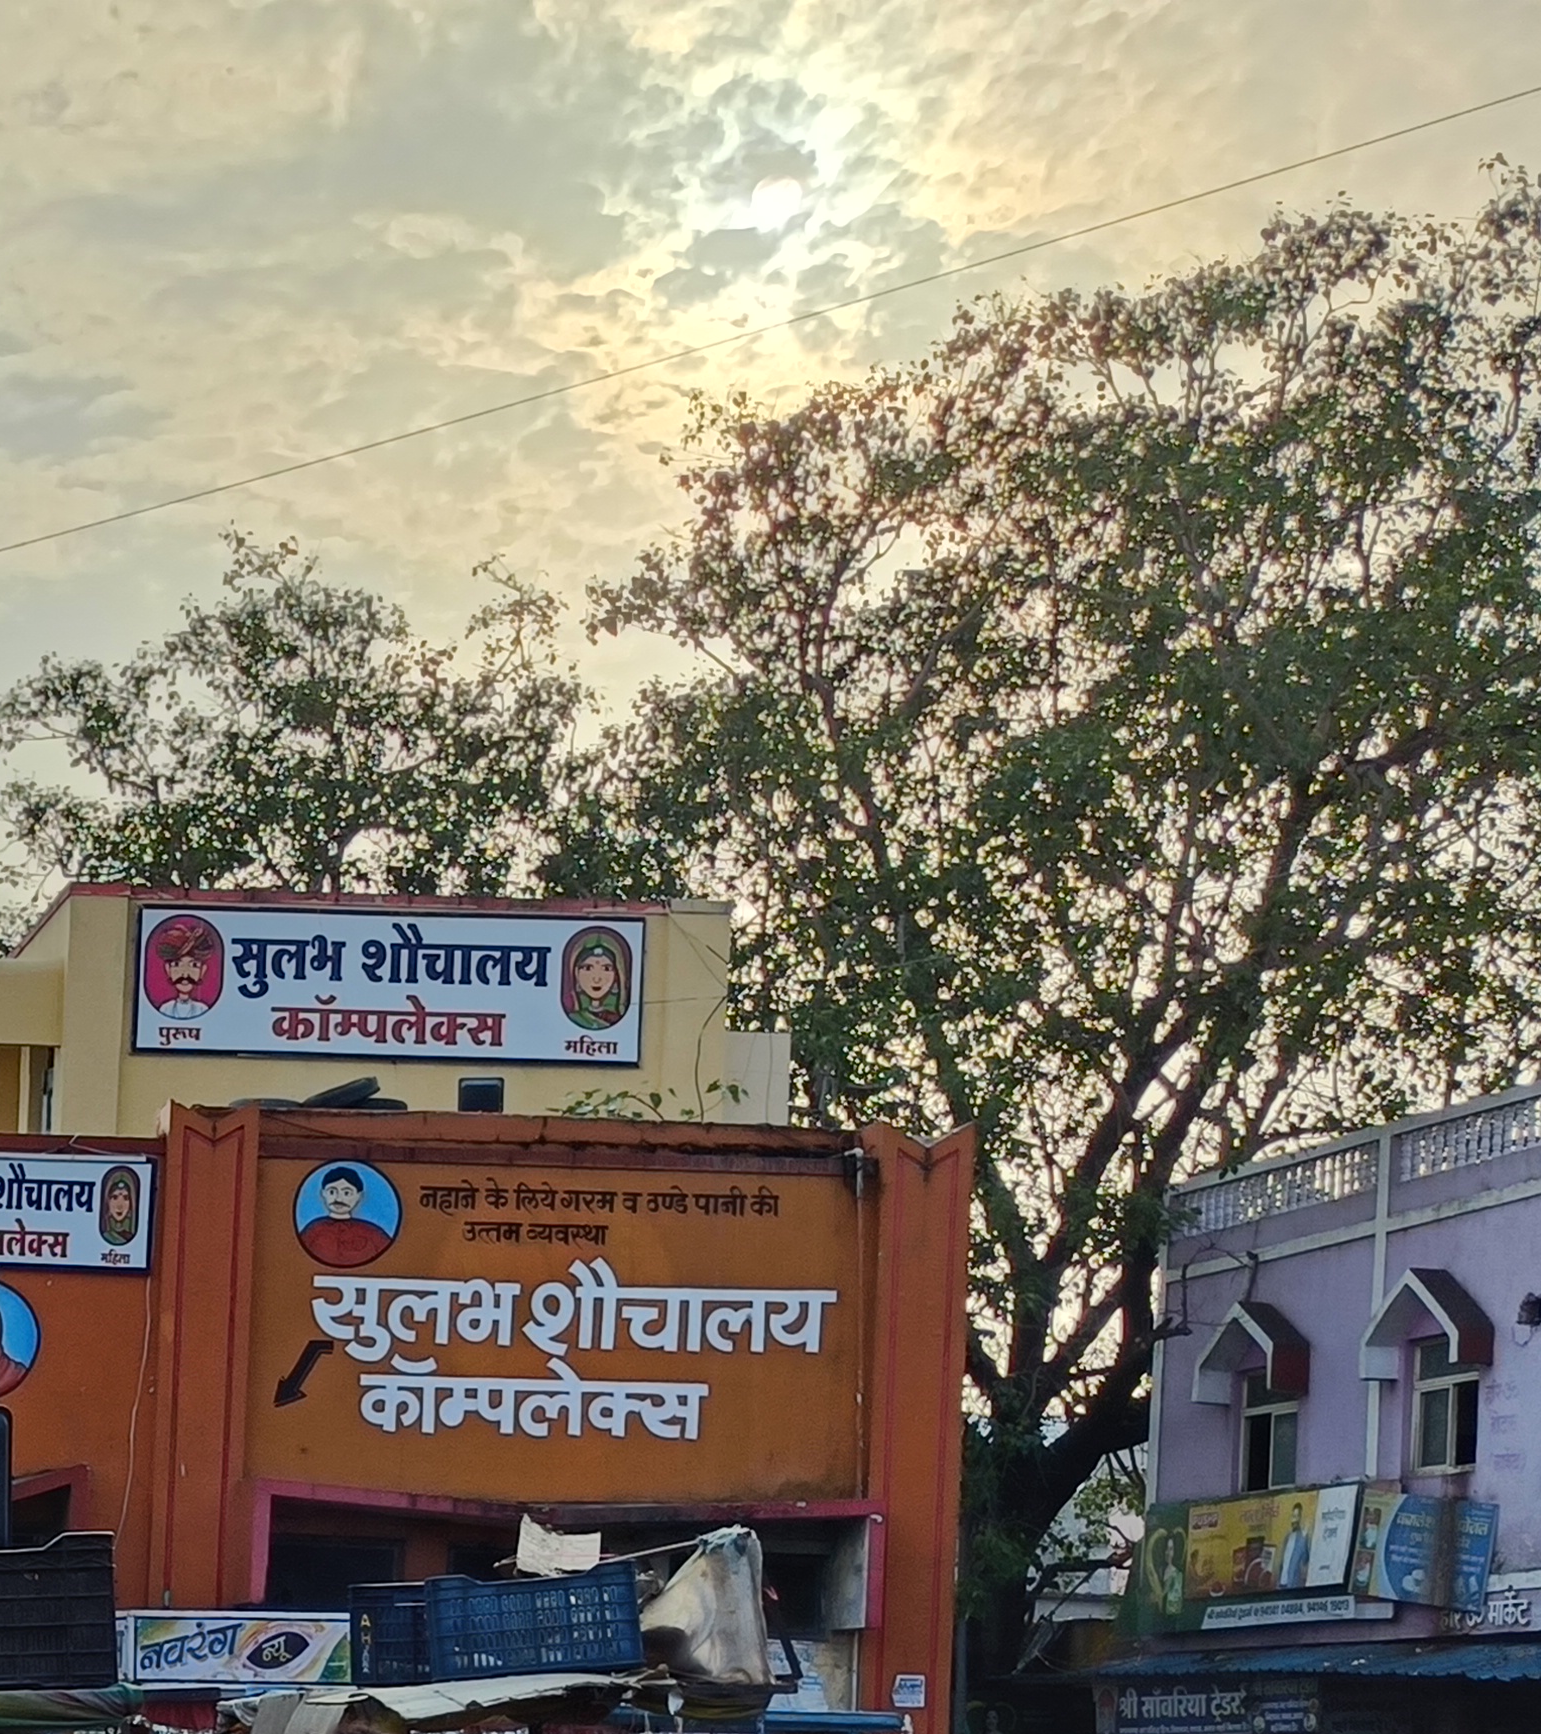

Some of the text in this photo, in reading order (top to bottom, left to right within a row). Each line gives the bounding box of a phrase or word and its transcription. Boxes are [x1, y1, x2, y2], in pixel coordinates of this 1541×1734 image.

[231, 922, 552, 999] सुलभ शौचालय
[270, 994, 507, 1047] कॉम्पलेक्स
[564, 1036, 618, 1055] महिला
[419, 1177, 780, 1218] नहाने के लिये गरम व ठण्डे पानी की
[100, 1250, 131, 1265] महिला
[462, 1222, 609, 1249] उत्तम व्यवस्था
[311, 1256, 838, 1364] सुलभ शौचालय
[358, 1354, 711, 1441] कॉम्पलेक्स
[140, 1623, 293, 1671] नवरंग न्यू
